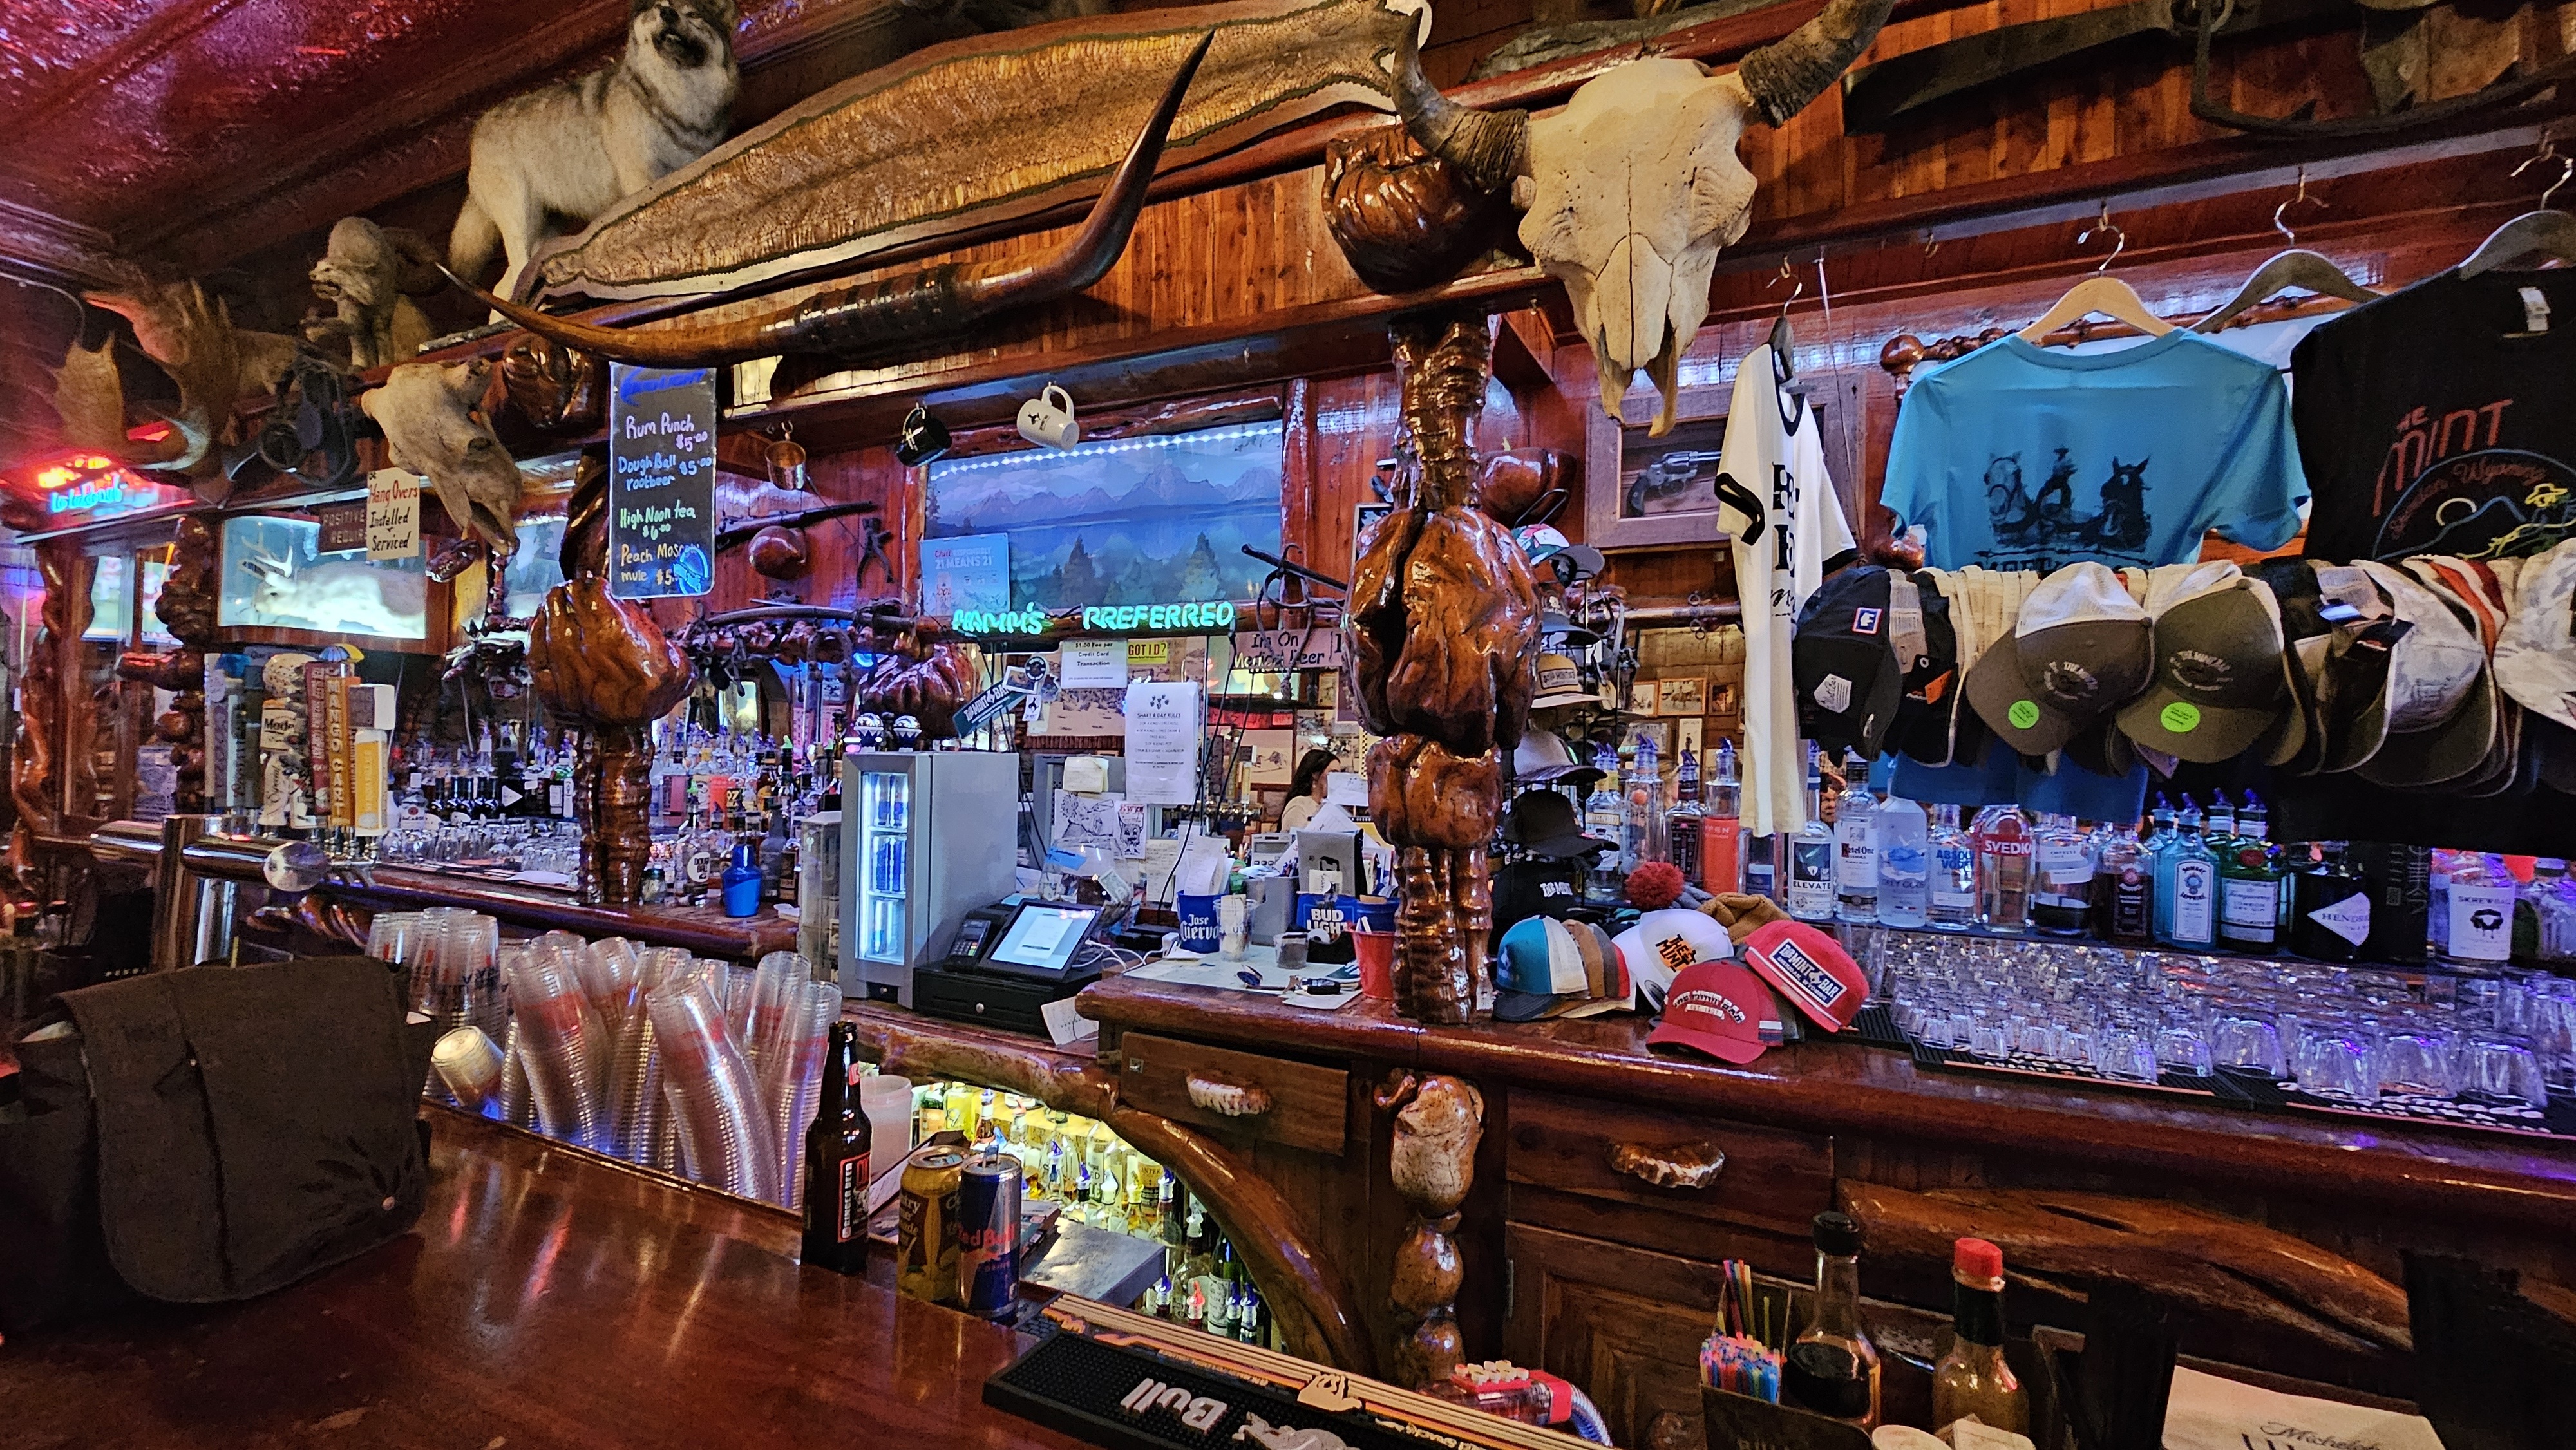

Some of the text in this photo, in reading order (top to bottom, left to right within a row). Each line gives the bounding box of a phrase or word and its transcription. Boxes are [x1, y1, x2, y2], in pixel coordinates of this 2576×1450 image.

[625, 412, 694, 440] Rum Punch
[618, 455, 652, 476] Dough
[654, 452, 676, 469] Ball
[2372, 397, 2514, 517] MINT
[368, 480, 417, 508] Hang Overs
[626, 475, 676, 491] rootbeer
[369, 507, 410, 528] Installed
[620, 499, 696, 532] High Noon tea
[372, 531, 412, 551] Serviced
[621, 543, 653, 567] Peach
[935, 556, 992, 570] 21 MEANS 21
[621, 569, 648, 583] mule
[1083, 601, 1235, 630] PREFERRED
[1128, 644, 1146, 655] GOT
[1278, 632, 1298, 646] On
[326, 681, 342, 751] MANGO
[331, 760, 345, 815] CART
[1311, 909, 1344, 921] BUD
[1655, 939, 1690, 972] MINT
[1669, 934, 1689, 956] THE
[1788, 952, 1815, 976] MINT
[1817, 978, 1839, 998] BAR
[983, 1224, 1016, 1246] Bull
[1119, 1377, 1228, 1434] Bull
